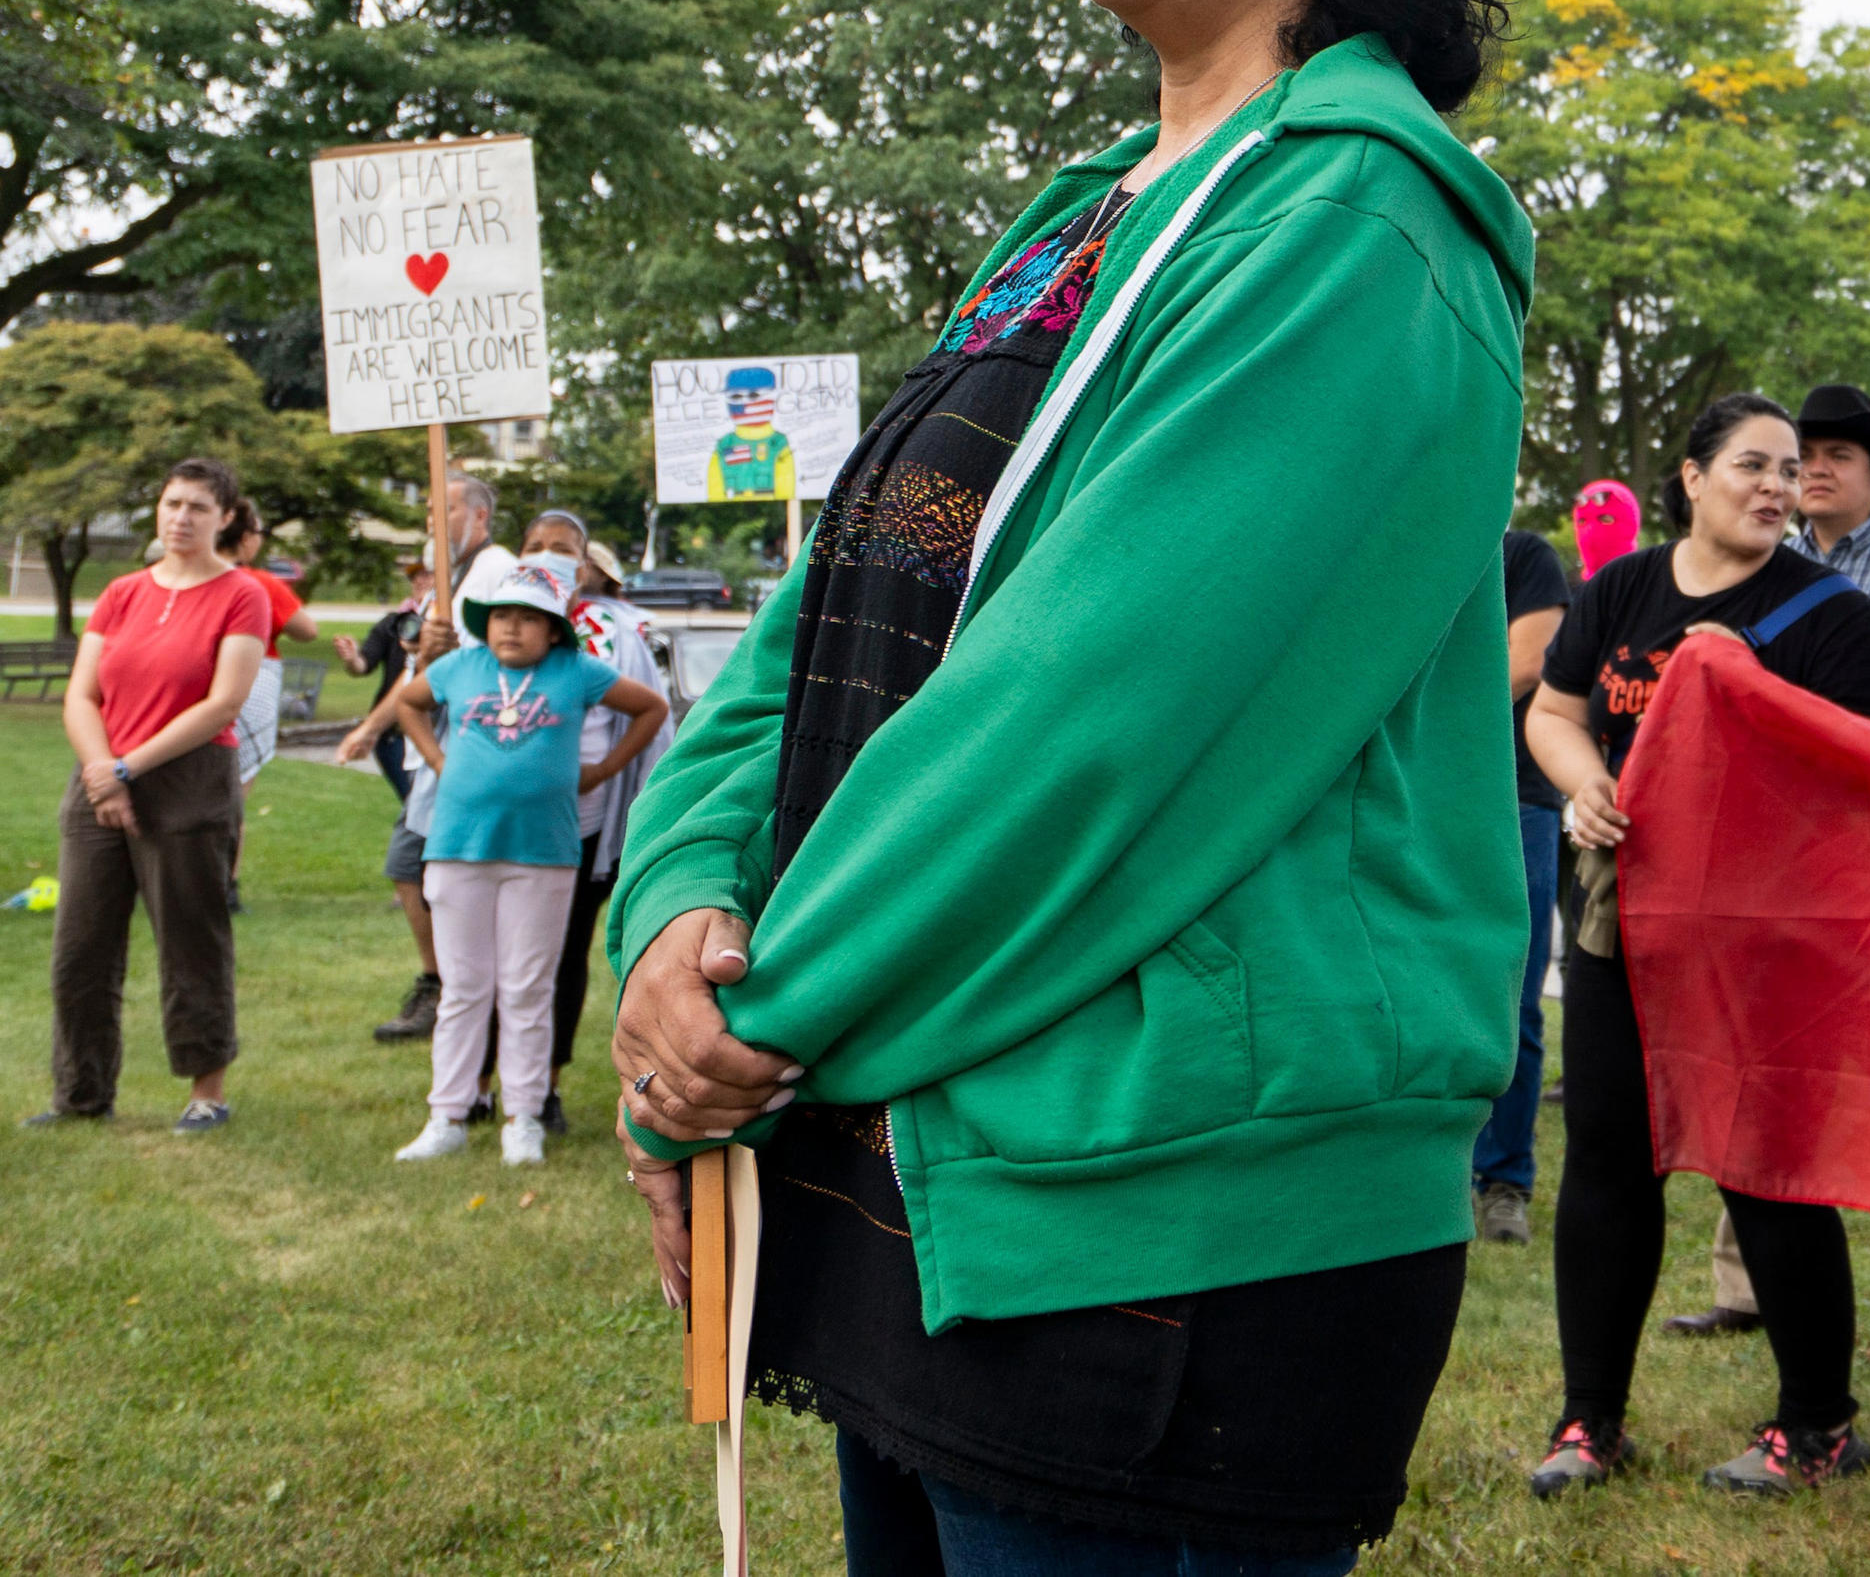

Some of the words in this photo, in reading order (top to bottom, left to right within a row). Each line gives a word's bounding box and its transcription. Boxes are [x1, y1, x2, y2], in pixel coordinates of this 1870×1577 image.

[336, 158, 381, 204] NO
[398, 148, 499, 198] HATE
[339, 212, 386, 258] NO
[402, 197, 511, 252] FEAR
[329, 291, 539, 346] IMMIGRANTS
[347, 344, 400, 383] ARE
[408, 332, 539, 379] WELCOME
[389, 376, 481, 422] HERE
